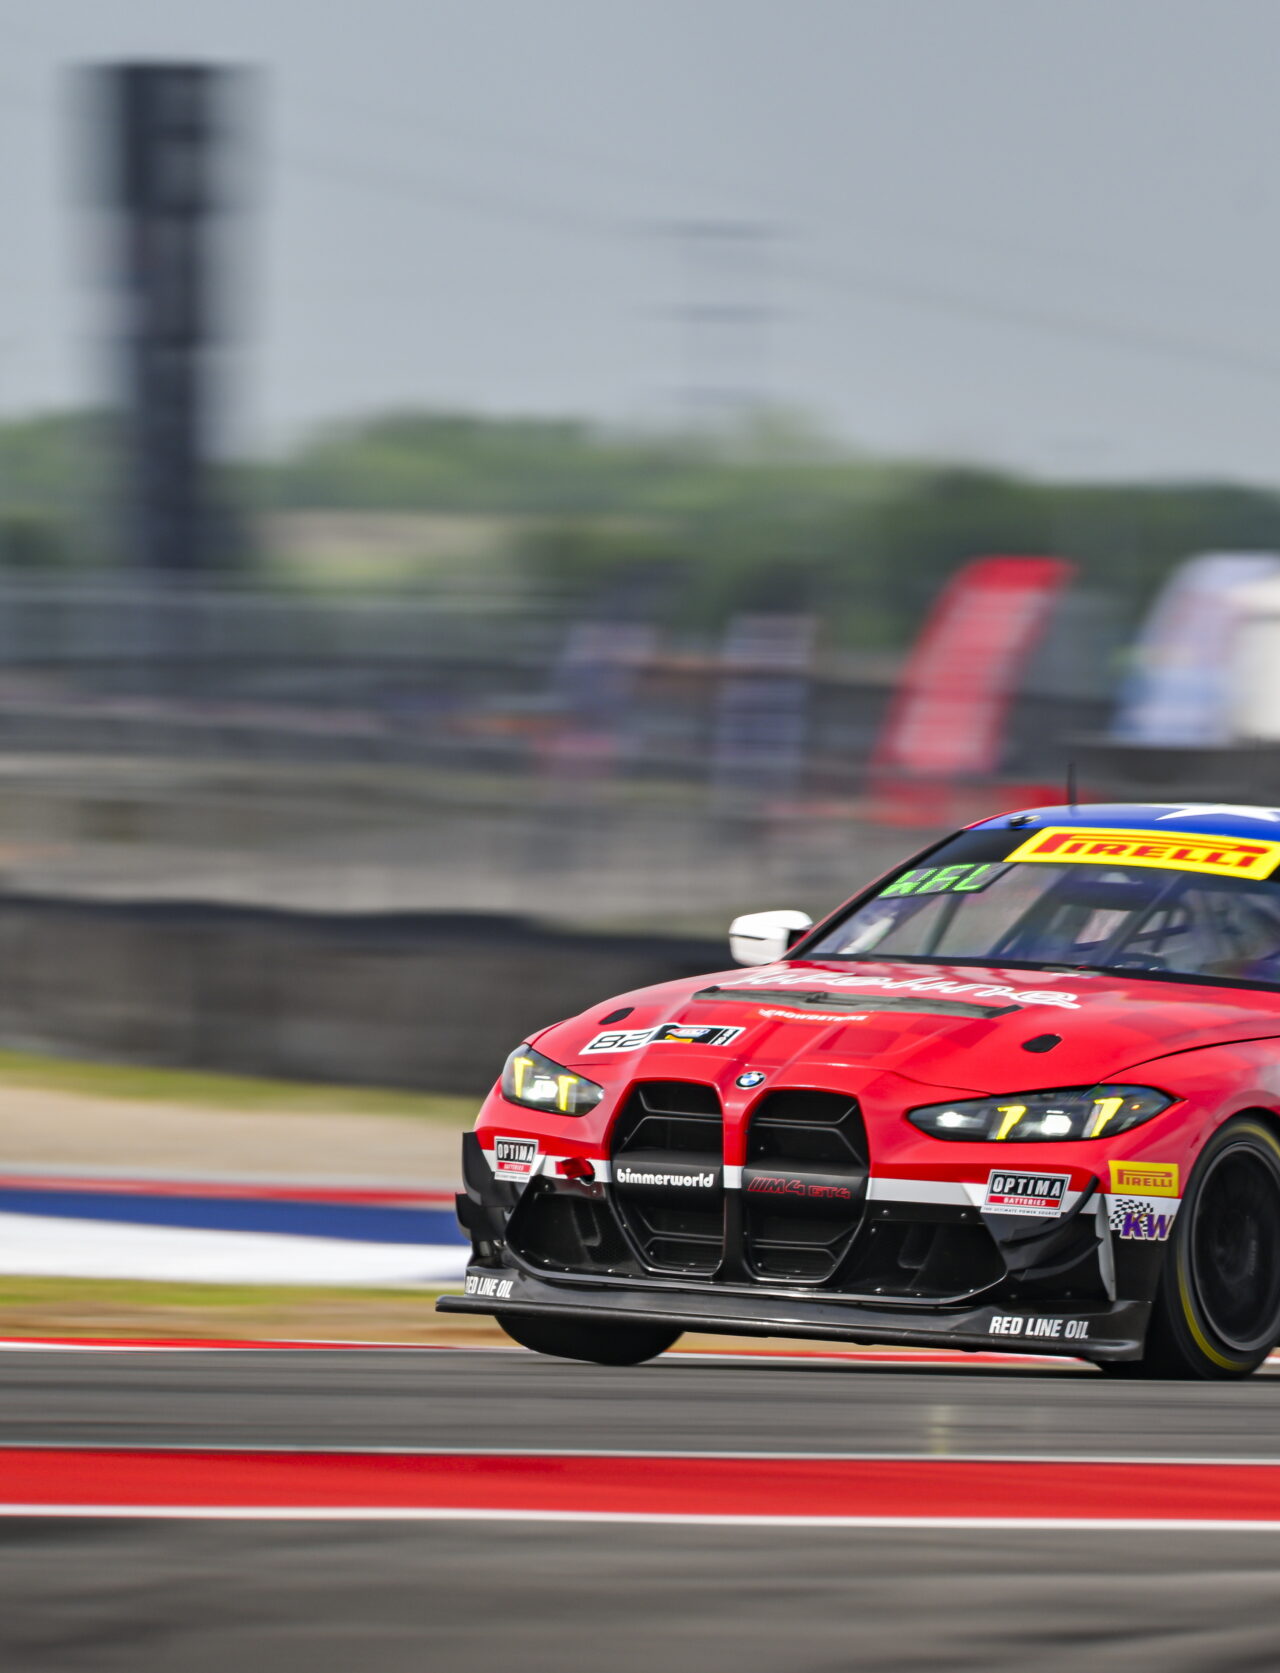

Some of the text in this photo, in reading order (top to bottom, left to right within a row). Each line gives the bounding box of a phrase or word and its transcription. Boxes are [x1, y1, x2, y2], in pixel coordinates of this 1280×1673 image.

[1036, 834, 1268, 868] PIRELLI
[588, 1030, 653, 1050] 82
[497, 1143, 534, 1162] OPTIMA
[616, 1167, 715, 1188] bimmerworld
[993, 1176, 1061, 1197] OPTIMA
[1117, 1168, 1173, 1188] PIRELLI
[808, 1185, 850, 1199] GT4
[1003, 1197, 1046, 1206] BATTERIES
[1121, 1212, 1174, 1240] KW
[477, 1277, 499, 1296] LINE
[496, 1279, 514, 1298] OIL
[989, 1316, 1089, 1339] RED LINE OIL
